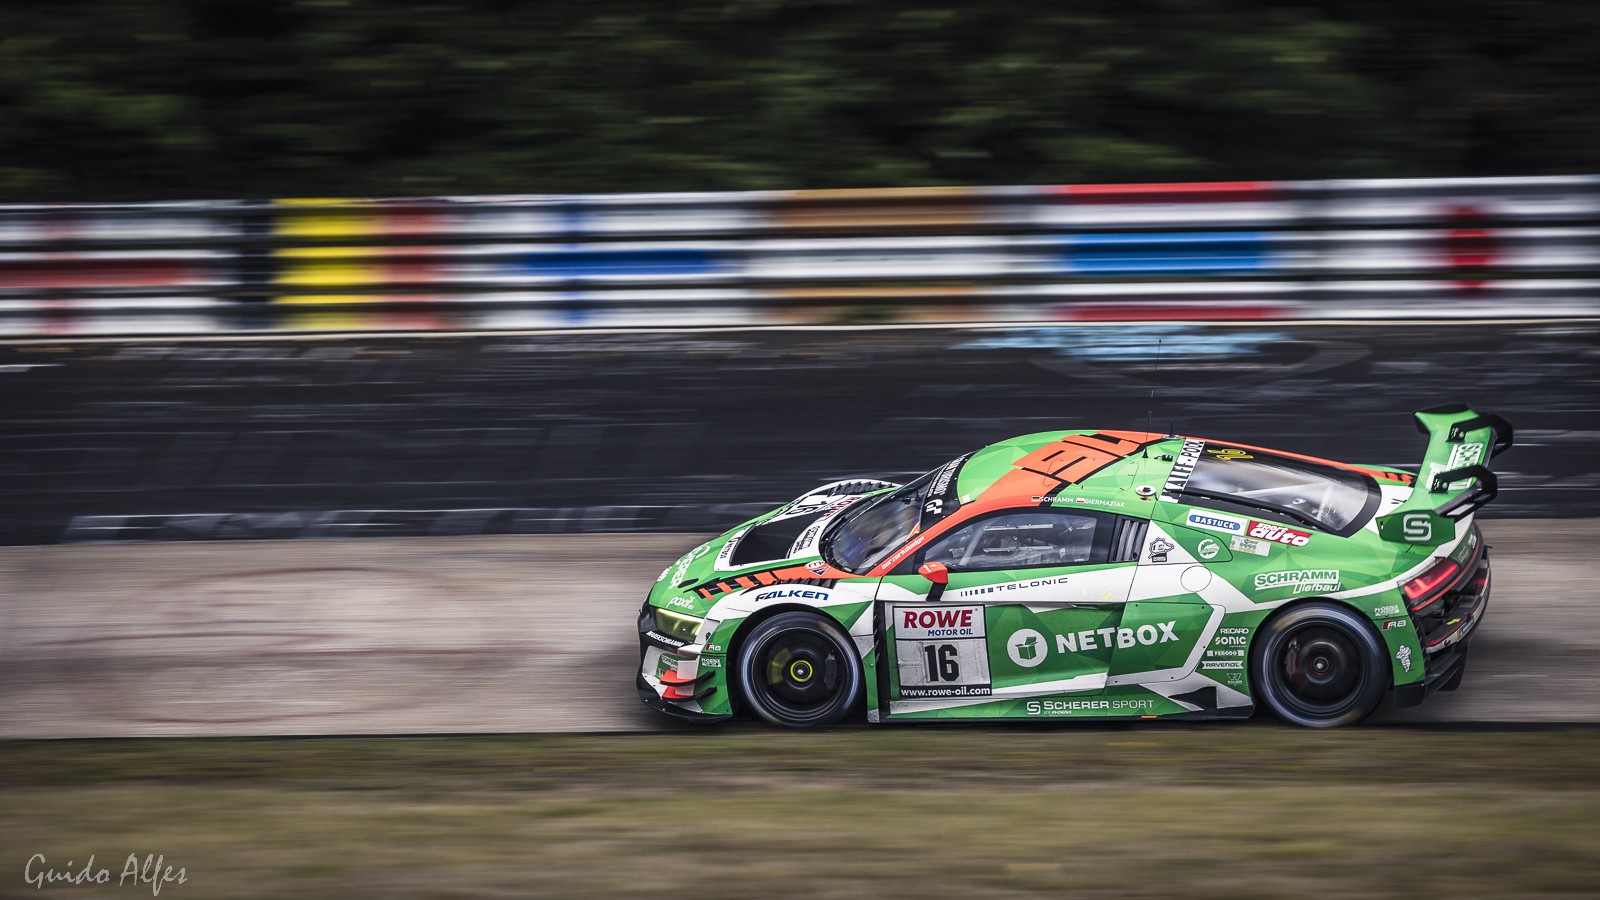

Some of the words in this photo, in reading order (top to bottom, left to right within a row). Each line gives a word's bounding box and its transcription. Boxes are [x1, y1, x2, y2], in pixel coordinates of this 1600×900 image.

[1084, 498, 1126, 508] GIERMAZIAK
[1195, 516, 1236, 530] BASTUCK
[1255, 522, 1289, 534] sport
[1249, 526, 1310, 547] auto
[995, 577, 1068, 592] TELONIC
[1255, 570, 1339, 587] SCHRAMM
[755, 589, 829, 602] FALKEN
[902, 609, 974, 629] ROWE
[1387, 620, 1407, 629] R8
[927, 629, 958, 637] MOTOR
[959, 628, 974, 636] OIL
[1056, 620, 1180, 654] NETBOX
[1220, 627, 1249, 635] RECARO
[924, 643, 960, 682] 16
[900, 686, 991, 697] www.rowe-oil.com
[1043, 700, 1109, 710] SCHERER
[1112, 699, 1155, 709] SPORT
